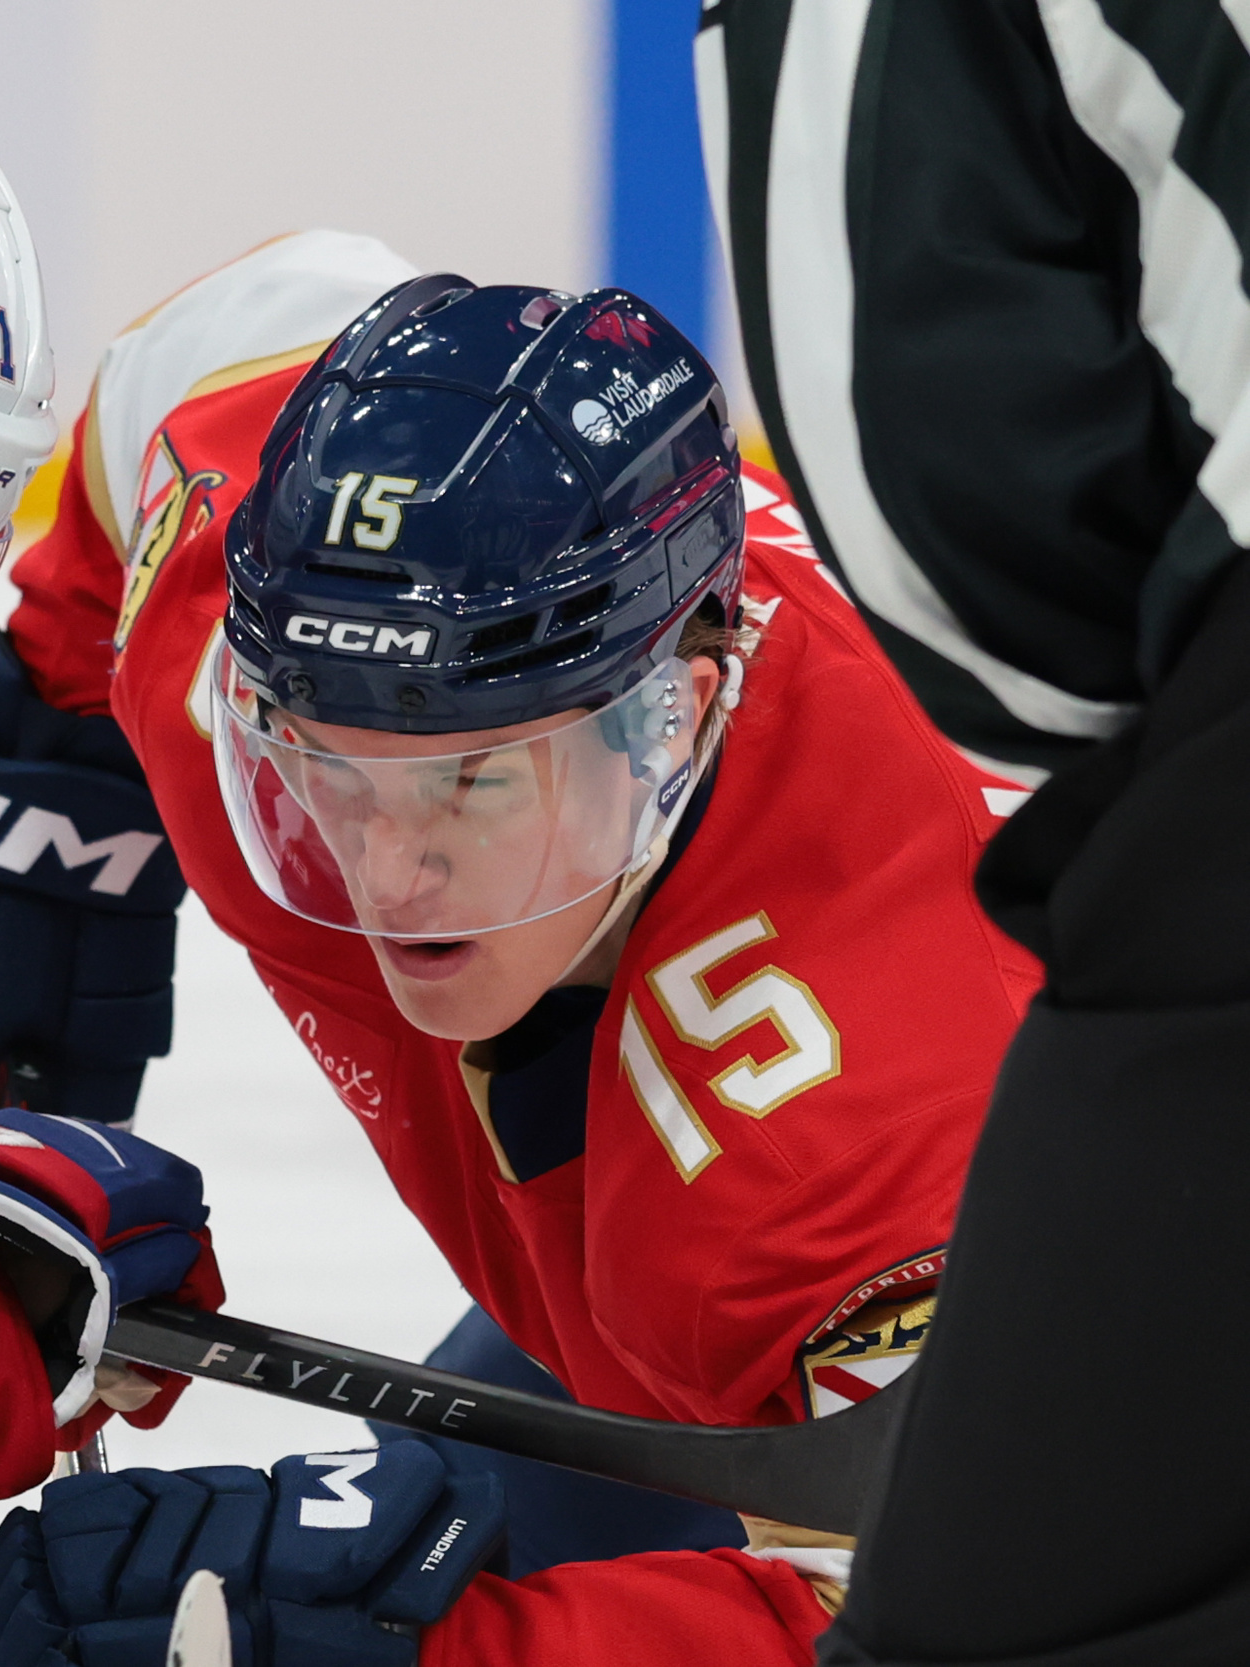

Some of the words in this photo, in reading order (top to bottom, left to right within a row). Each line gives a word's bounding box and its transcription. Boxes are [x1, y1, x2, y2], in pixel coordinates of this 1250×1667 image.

[599, 371, 640, 407] VISIT
[611, 358, 695, 428] LAUDERDALE
[324, 471, 419, 552] 15
[285, 614, 432, 656] CCM
[661, 768, 689, 804] CCM
[618, 909, 842, 1185] 15
[825, 1255, 948, 1331] FLORID
[196, 1341, 477, 1428] FLYLITE
[420, 1518, 467, 1572] LUNDELL
